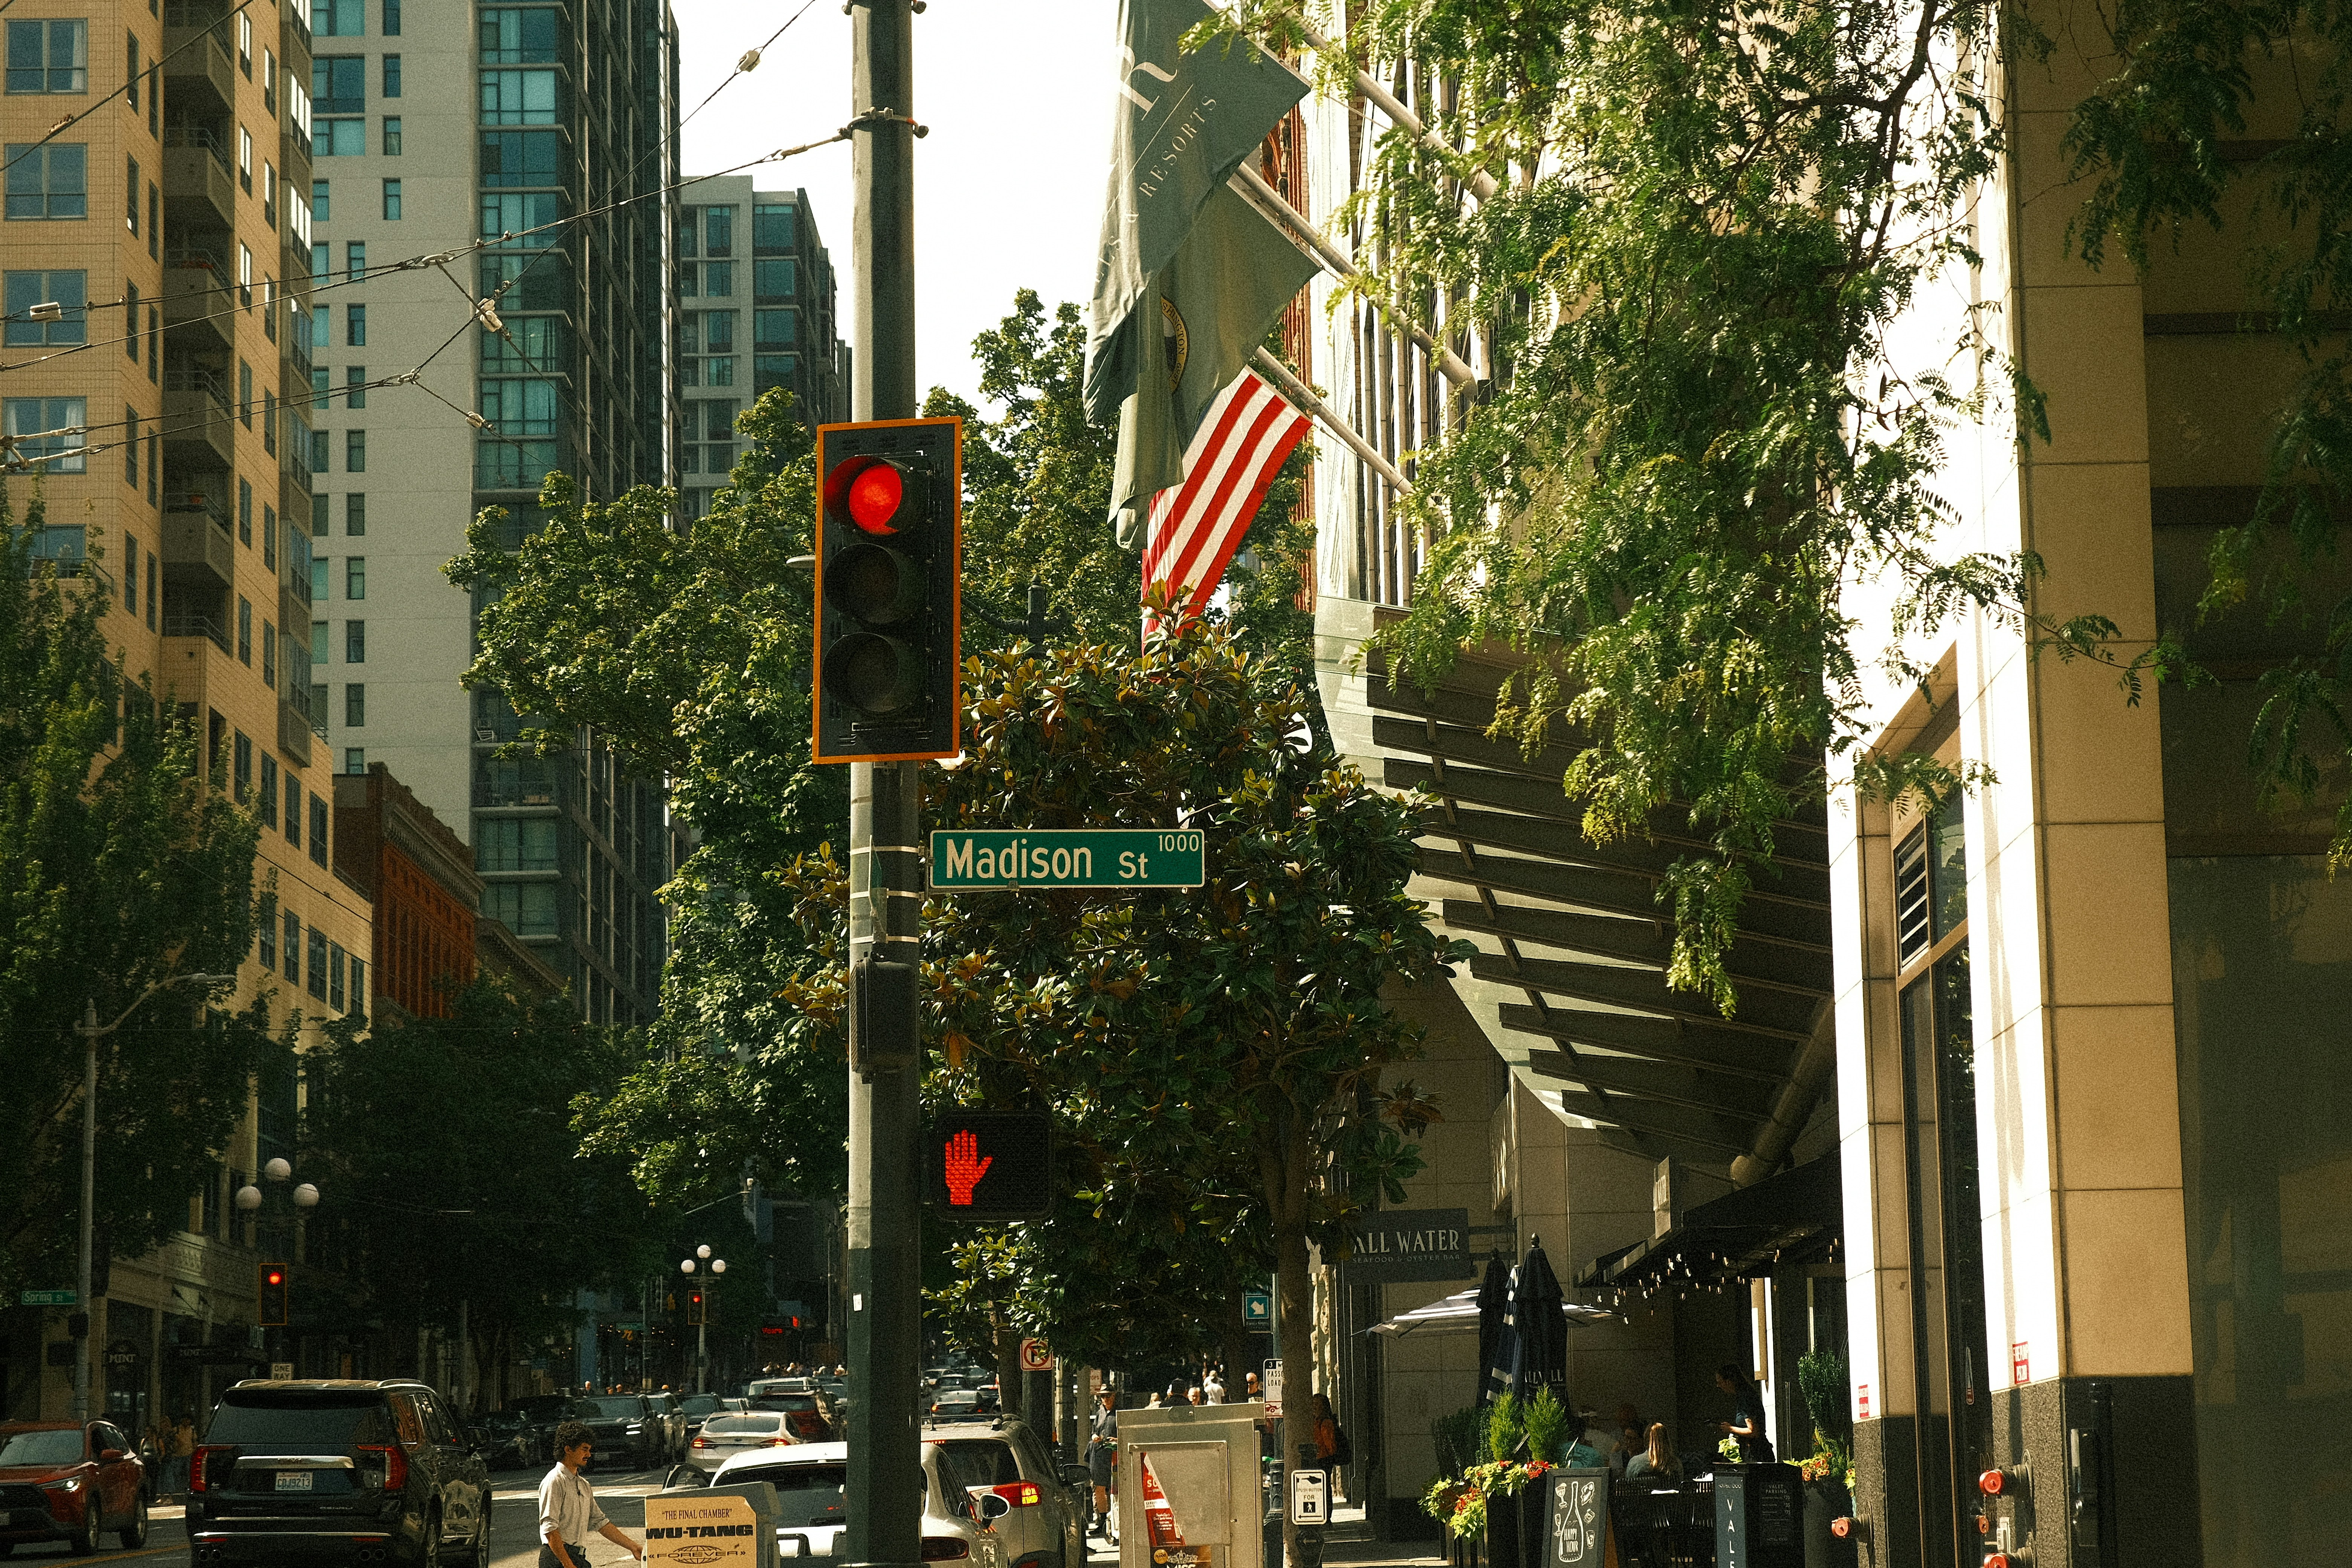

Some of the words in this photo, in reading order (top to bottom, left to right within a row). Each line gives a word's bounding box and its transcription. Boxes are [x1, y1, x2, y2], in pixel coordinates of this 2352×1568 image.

[1139, 95, 1216, 198] RESORTS
[946, 838, 1092, 879] Madison
[1118, 851, 1148, 879] St
[1159, 835, 1199, 852] 1000
[1396, 1230, 1459, 1255] WATER
[25, 1292, 52, 1303] Spring
[679, 1510, 697, 1519] FINAL
[646, 1525, 753, 1539] WU-TANG
[1564, 1528, 1577, 1541] HAPPY
[1566, 1540, 1579, 1553] HOUR
